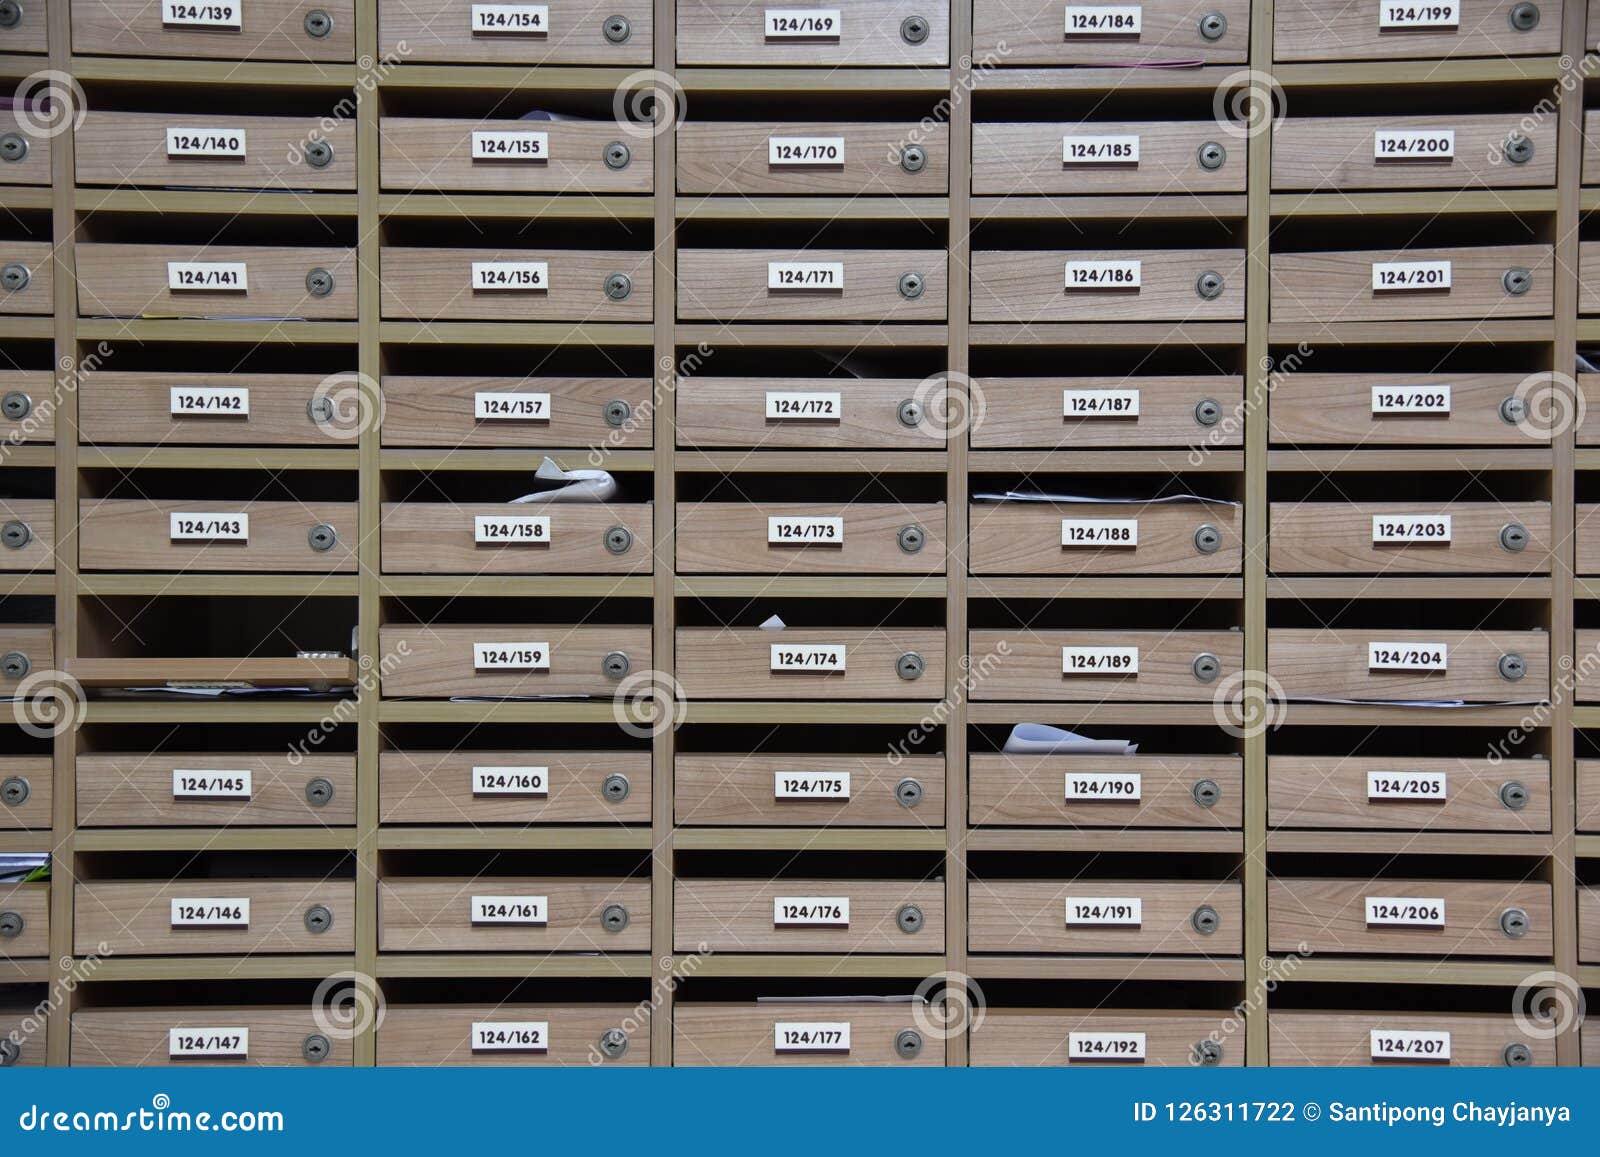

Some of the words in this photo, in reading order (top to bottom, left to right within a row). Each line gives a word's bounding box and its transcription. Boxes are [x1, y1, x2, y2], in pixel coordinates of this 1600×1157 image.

[169, 4, 234, 22] 124/139
[478, 12, 542, 28] 124/154
[1070, 13, 1136, 29] 124/184
[1388, 5, 1453, 22] 124/199
[771, 16, 834, 32] 124/169
[172, 135, 240, 152] 124/140
[479, 138, 541, 155] 124/155
[1070, 142, 1133, 158] 124/185
[1379, 137, 1451, 154] 124/200
[775, 144, 838, 160] 124/170
[176, 269, 239, 286] 124/141
[479, 269, 541, 285] 124/156
[777, 269, 834, 285] 124/171
[1071, 268, 1135, 284] 124/186
[1379, 268, 1444, 286] 124/201
[177, 394, 242, 411] 124/142
[482, 399, 544, 415] 124/157
[773, 399, 834, 415] 124/172
[1070, 397, 1133, 412] 124/187
[1377, 392, 1446, 408] 124/202
[177, 519, 242, 536] 124/143
[482, 523, 544, 538] 124/158
[775, 523, 836, 539] 124/173
[1068, 526, 1131, 542] 124/188
[1378, 522, 1446, 538] 124/203
[481, 649, 543, 665] 124/159
[777, 651, 839, 667] 124/174
[1069, 654, 1132, 669] 124/189
[1373, 649, 1443, 666] 124/204
[180, 776, 245, 792] 124/145
[479, 774, 543, 790] 124/160
[782, 778, 843, 794] 124/175
[1071, 779, 1136, 796] 124/190
[1373, 778, 1441, 795] 124/205
[178, 905, 243, 921] 124/146
[480, 903, 539, 919] 124/161
[782, 904, 842, 920] 124/176
[1074, 904, 1133, 920] 124/191
[1371, 904, 1440, 921] 124/206
[177, 1035, 241, 1051] 124/147
[478, 1029, 541, 1045] 124/162
[783, 1030, 843, 1045] 124/177
[1076, 1039, 1139, 1054] 124/192
[1377, 1037, 1445, 1055] 124/207
